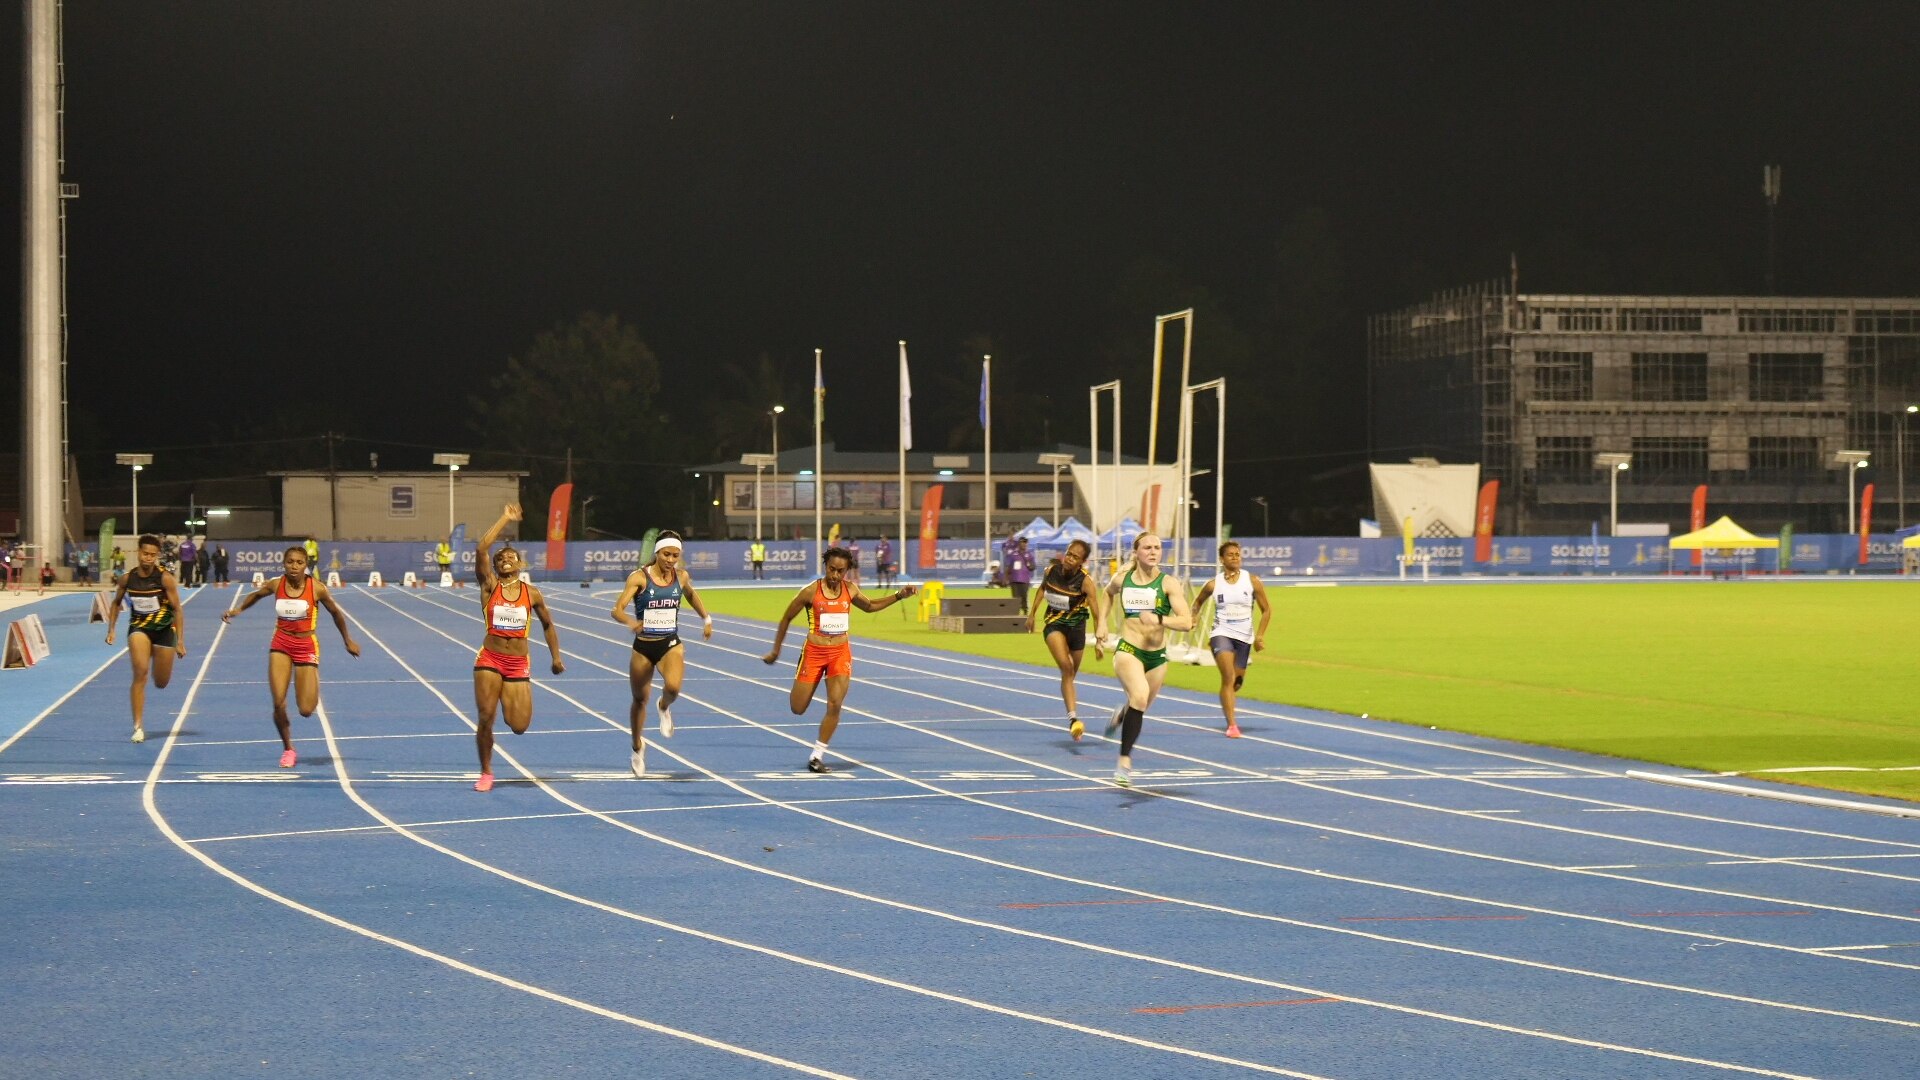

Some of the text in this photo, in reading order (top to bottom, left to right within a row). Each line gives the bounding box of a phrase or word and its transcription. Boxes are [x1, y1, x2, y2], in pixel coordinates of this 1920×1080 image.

[236, 551, 284, 563] SOL20
[584, 551, 640, 562] SOL202
[744, 550, 807, 562] SL2023
[934, 548, 985, 560] OL2023
[1241, 546, 1292, 558] OL2023
[1414, 546, 1464, 558] OL2023
[648, 599, 679, 608] GUAM
